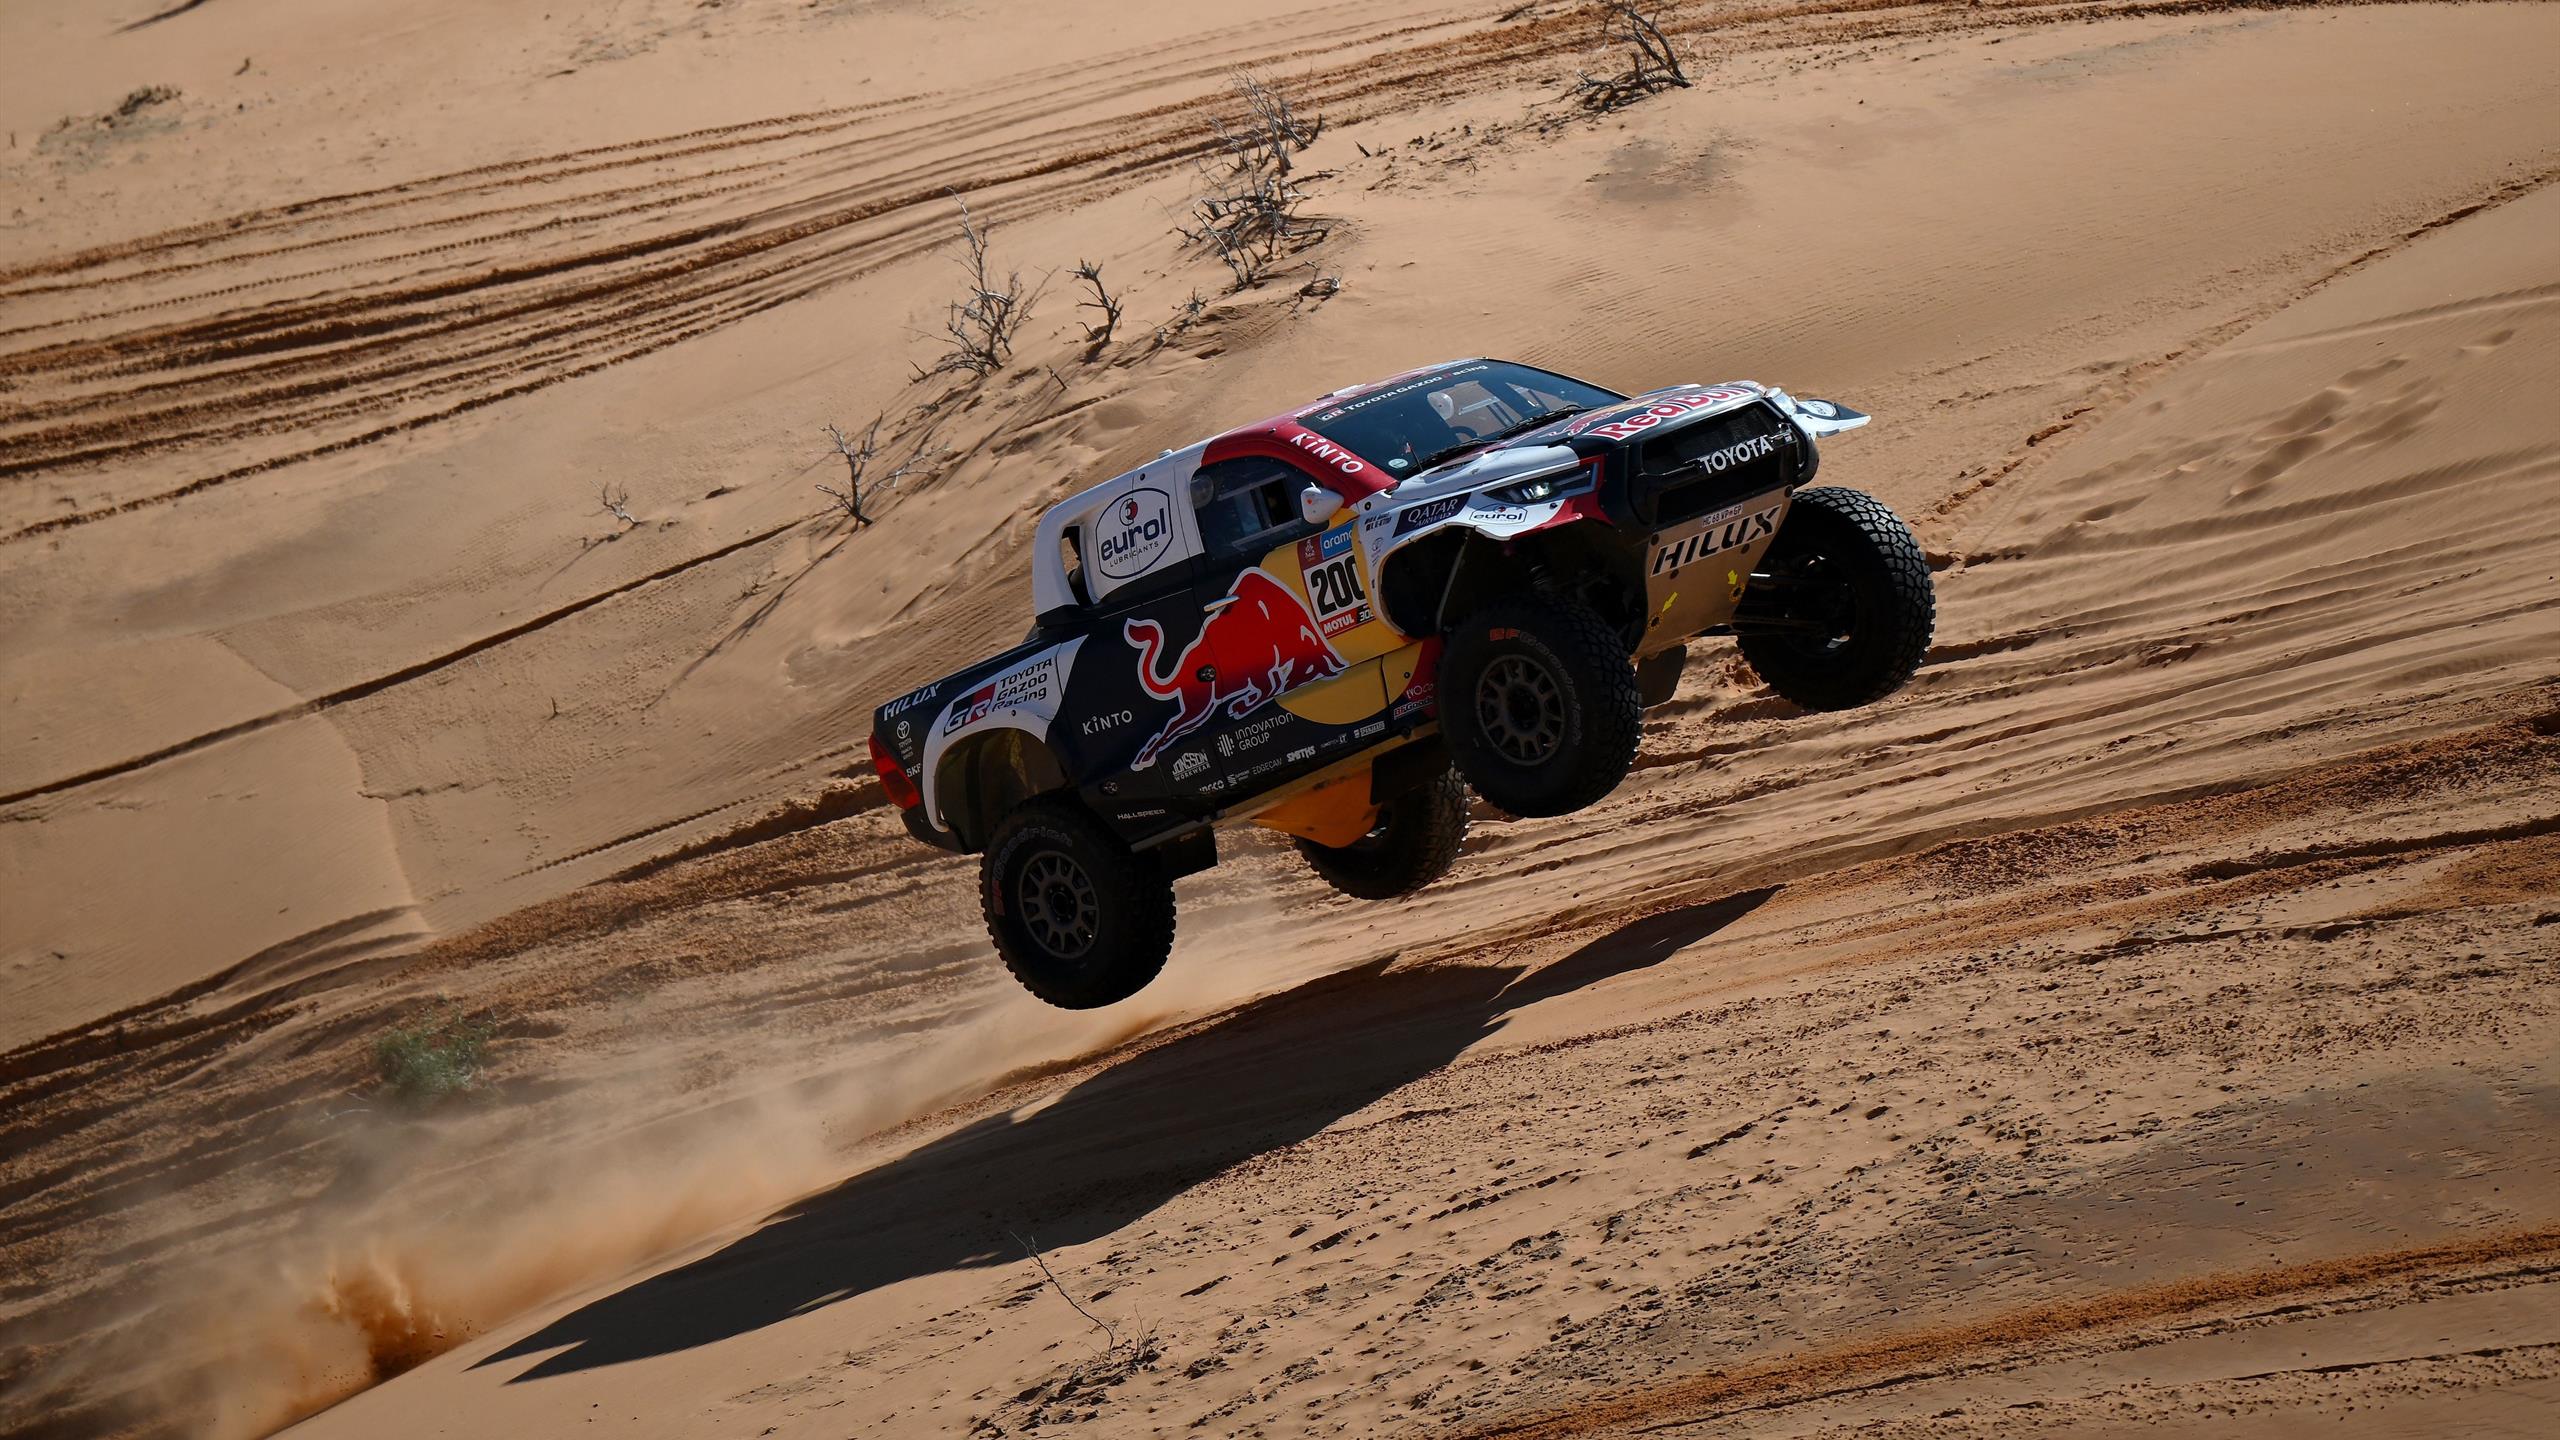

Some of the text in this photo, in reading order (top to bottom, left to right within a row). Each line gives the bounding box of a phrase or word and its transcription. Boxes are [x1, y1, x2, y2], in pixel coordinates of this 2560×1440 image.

[1344, 391, 1395, 411] TOYOTA
[1396, 377, 1442, 394] GAZOO
[1700, 437, 1773, 474] TOYOTA
[1408, 498, 1458, 523] QATAR
[1473, 512, 1522, 521] eurol
[1101, 508, 1166, 561] eurol
[1652, 506, 1781, 576] HILUX
[1109, 540, 1159, 567] LUBRICANTS
[1324, 614, 1354, 634] MOTUL
[1001, 657, 1052, 688] TOYOTA
[992, 687, 1047, 712] Racing
[997, 673, 1048, 701] GAZOO
[883, 682, 942, 721] HILUX
[945, 698, 991, 735] GR
[1238, 731, 1270, 750] GROUP
[906, 763, 921, 777] SKF
[1172, 751, 1209, 776] JONSSON
[1174, 763, 1211, 782] WORKWEAR
[1117, 808, 1165, 820] HALLSPEED
